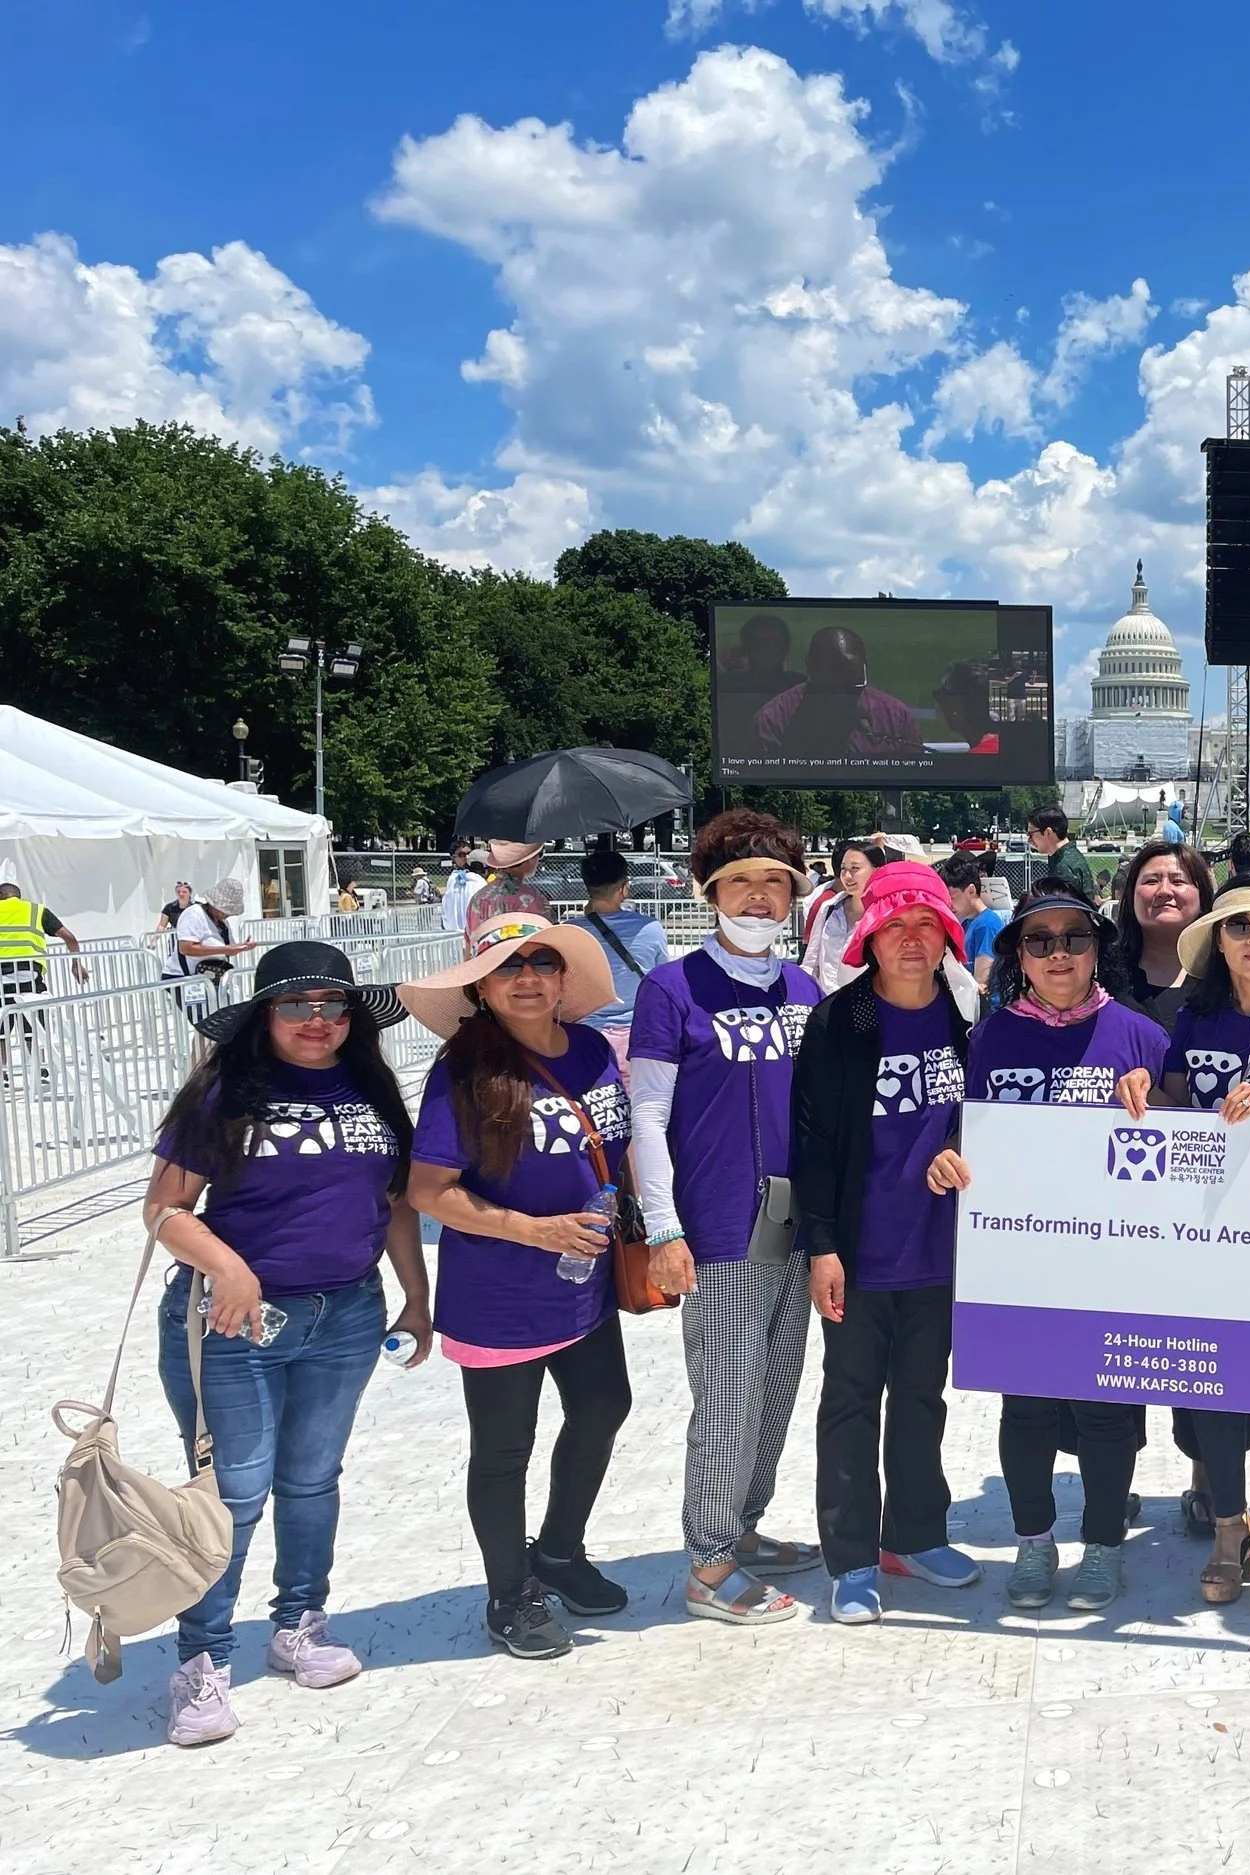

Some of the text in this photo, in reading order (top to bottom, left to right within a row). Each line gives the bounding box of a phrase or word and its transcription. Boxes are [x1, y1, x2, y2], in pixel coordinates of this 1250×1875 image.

[747, 759, 763, 767] you
[809, 759, 825, 767] you
[776, 1004, 813, 1017] KORE
[923, 1046, 958, 1063] KORE
[924, 1058, 962, 1074] AMERIC
[1051, 1066, 1114, 1080] KOREAN
[925, 1067, 966, 1089] FAMI
[1050, 1079, 1114, 1090] AMERICAN
[582, 1083, 624, 1106] KORE
[926, 1084, 957, 1096] SERVICE
[1050, 1088, 1114, 1103] FAMILY
[590, 1095, 630, 1115] AMERIC
[928, 1091, 965, 1106] 뉴욕가정
[333, 1103, 379, 1115] KORE
[338, 1114, 387, 1123] AMERIC
[592, 1104, 630, 1130] FAM
[340, 1123, 396, 1136] FAMIL
[1171, 1130, 1226, 1144] KOREAN
[344, 1143, 400, 1156] 뉴욕가정상
[1171, 1142, 1226, 1154] AMERICAN
[1170, 1152, 1226, 1168] FAMILY
[1170, 1166, 1225, 1175] SERVICE CENTER
[1169, 1173, 1225, 1185] 뉴욕가정상담소
[970, 1211, 1102, 1241] Transforming
[1108, 1219, 1166, 1240] Lives.
[1173, 1222, 1211, 1243] You
[1103, 1332, 1219, 1354] 24-Hour Hotline
[1103, 1353, 1218, 1375] 718-460-3800
[1096, 1373, 1225, 1397] WWW.KAFSC.ORG
